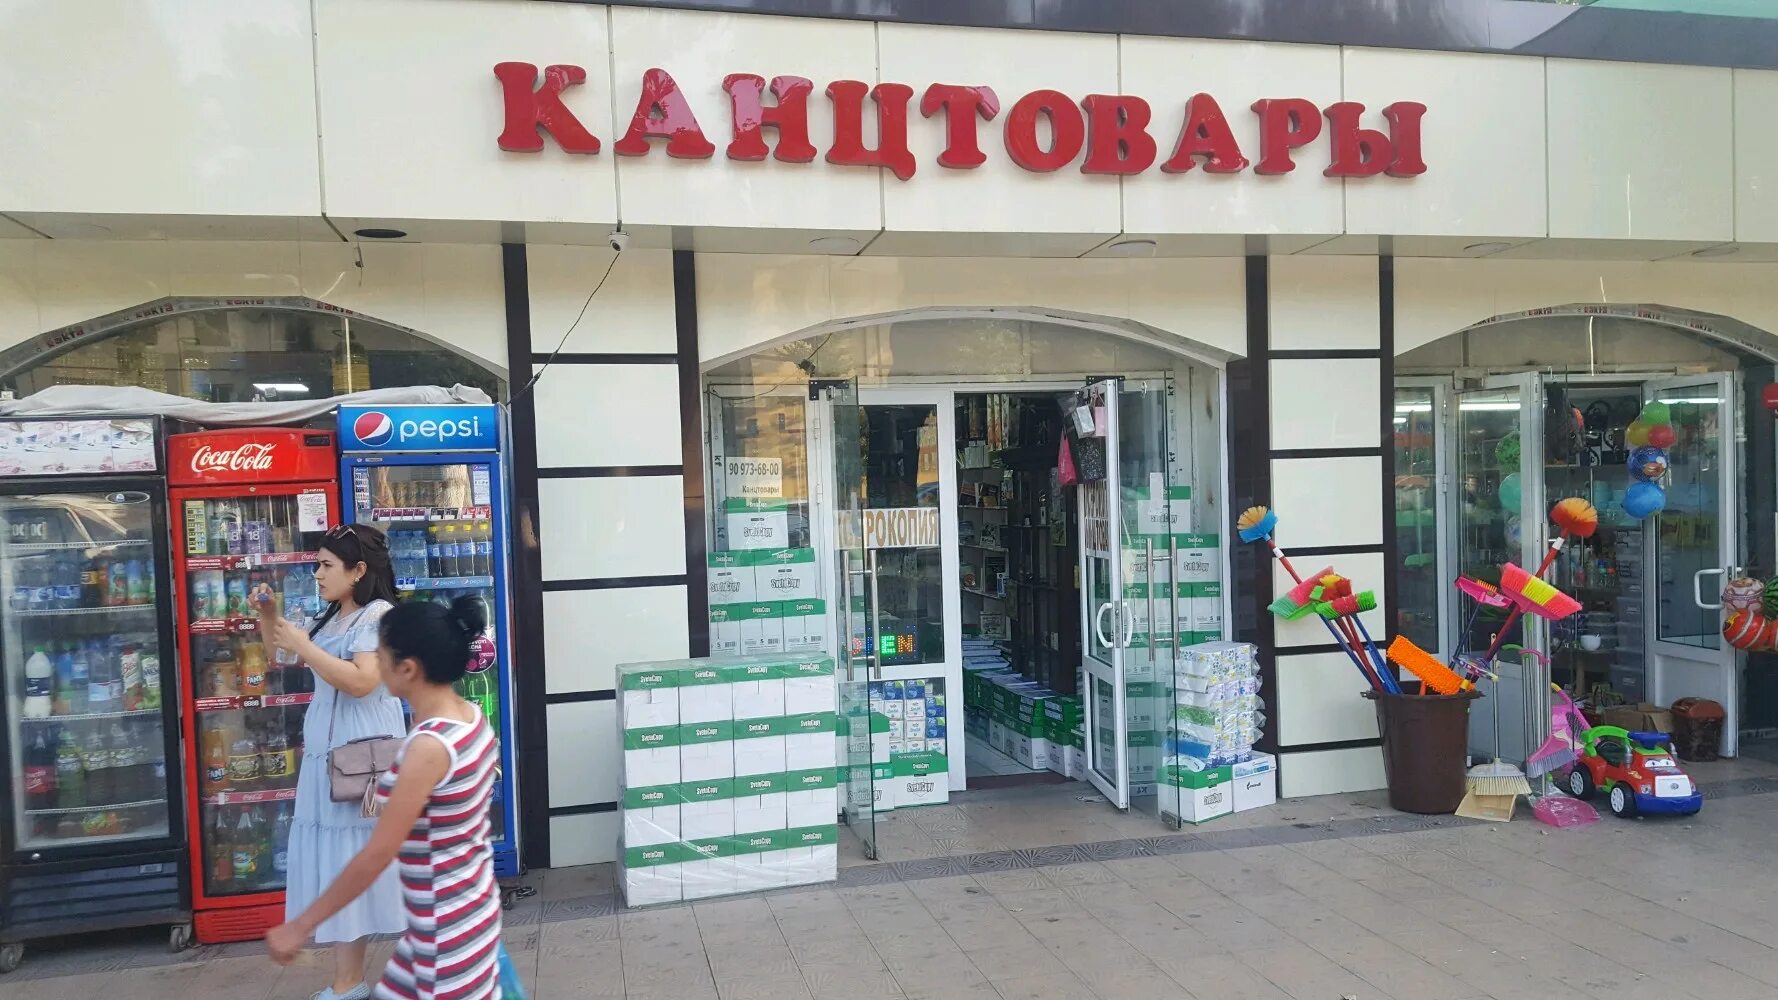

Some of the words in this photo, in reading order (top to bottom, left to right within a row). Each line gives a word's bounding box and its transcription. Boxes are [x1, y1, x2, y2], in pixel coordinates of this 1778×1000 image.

[494, 62, 1427, 181] КАНЦТОВАРЫ
[400, 416, 479, 442] pepsi
[191, 443, 277, 472] Coca-Cola
[729, 463, 738, 475] 90
[741, 463, 779, 475] 973-68-00
[742, 485, 780, 495] Канцтовары
[838, 508, 938, 547] КРОКОПИЯ
